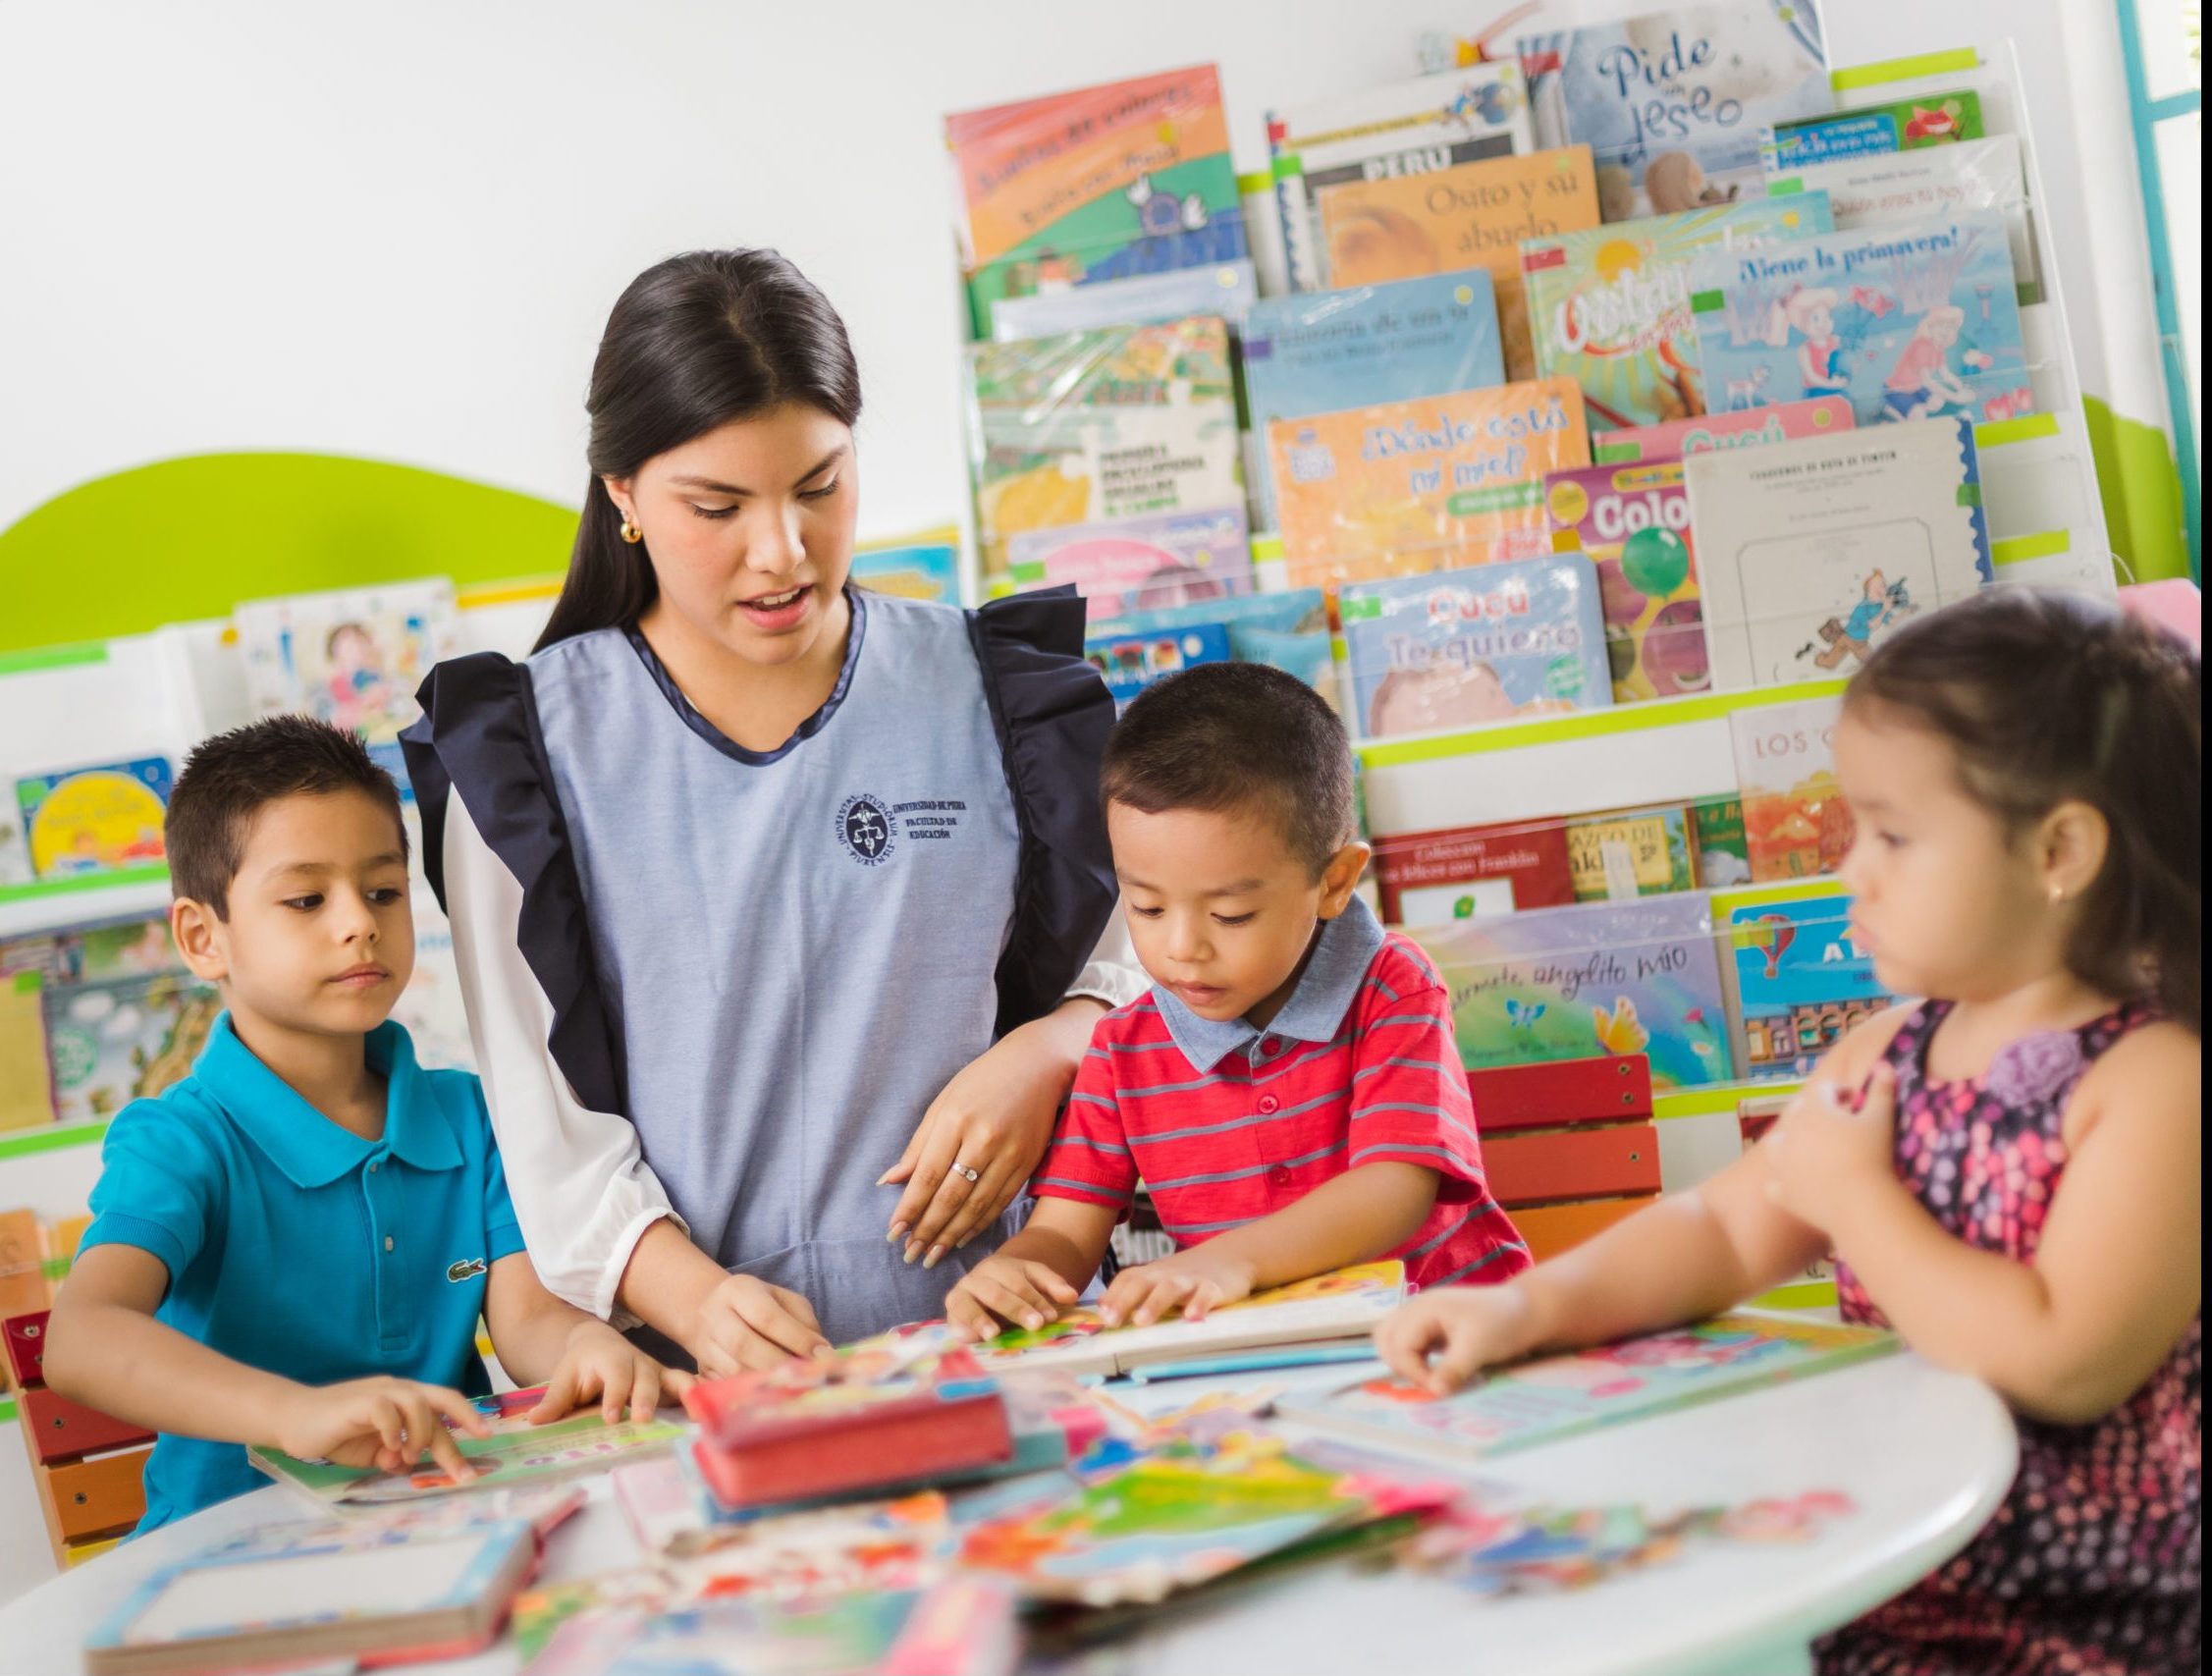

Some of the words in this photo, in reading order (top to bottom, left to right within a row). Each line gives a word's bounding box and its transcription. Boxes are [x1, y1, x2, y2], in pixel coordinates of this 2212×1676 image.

[1597, 30, 1715, 98] Pide
[1427, 178, 1511, 217] Osito
[1519, 179, 1537, 209] y
[1545, 172, 1580, 195] su
[1457, 213, 1560, 254] abuelo
[1815, 247, 1836, 269] la
[1843, 225, 1958, 273] primavera!
[1389, 636, 1429, 667] Te
[1446, 622, 1582, 668] quiero
[1754, 730, 1807, 760] LOS
[892, 801, 937, 814] UNIVERSIDAD
[905, 817, 944, 828] FACULTAD
[945, 817, 957, 827] DE
[909, 828, 951, 839] EDUCACIÓN
[1534, 948, 1627, 1004] angelito
